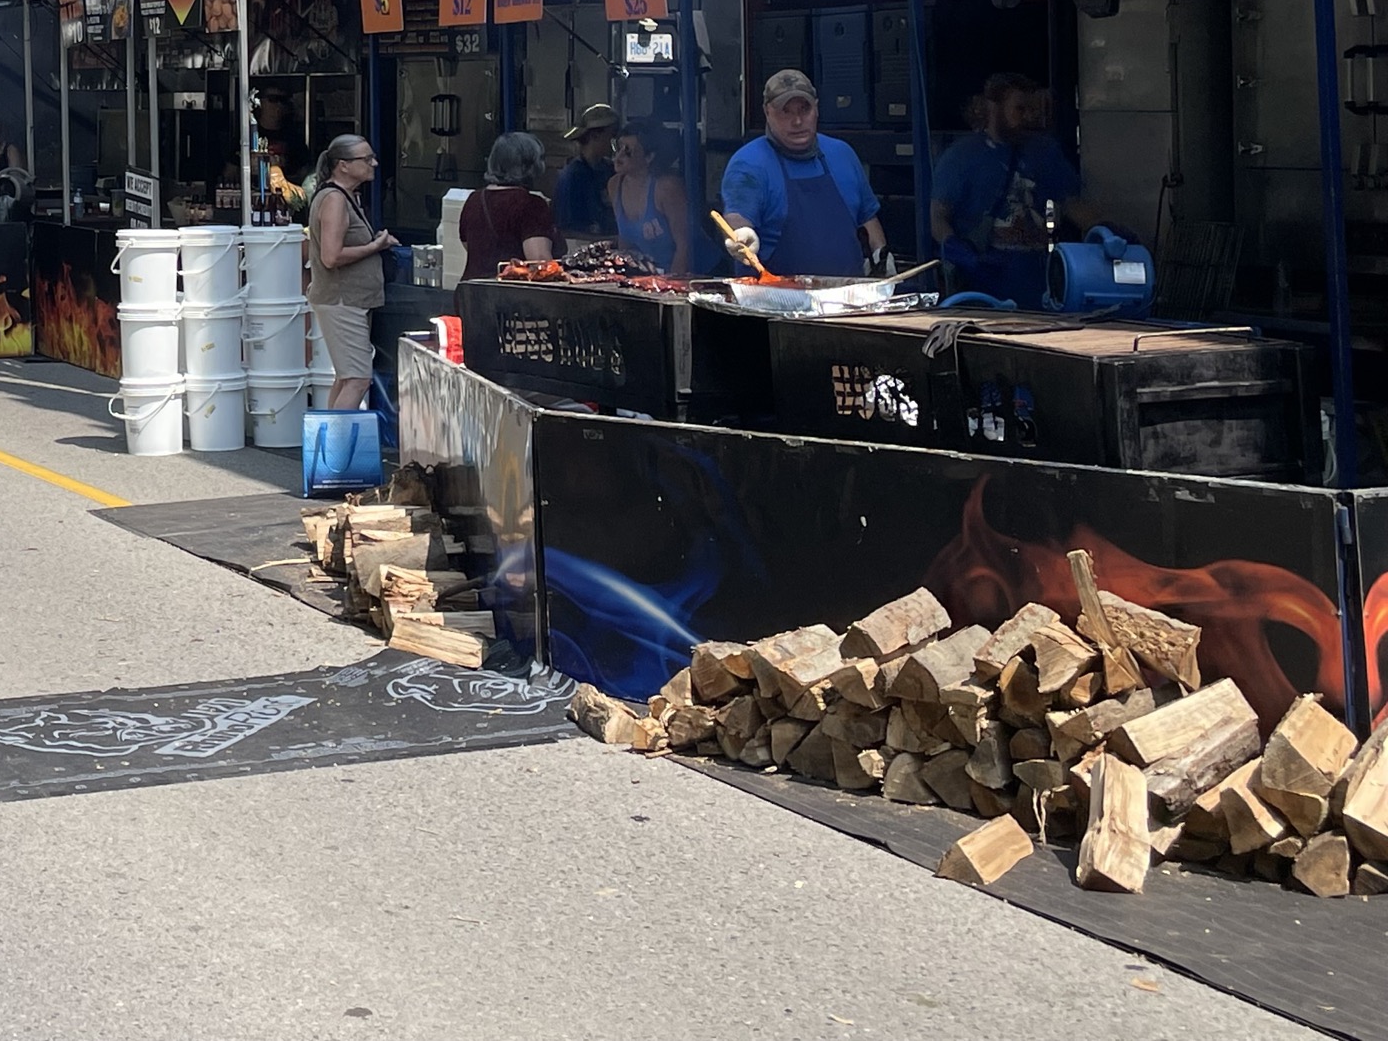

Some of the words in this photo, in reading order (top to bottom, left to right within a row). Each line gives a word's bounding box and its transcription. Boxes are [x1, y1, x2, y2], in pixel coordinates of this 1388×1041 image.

[68, 20, 84, 44] $10
[149, 16, 161, 35] $12
[455, 33, 480, 53] $32
[126, 175, 134, 191] WE
[134, 177, 152, 195] ACCEPT
